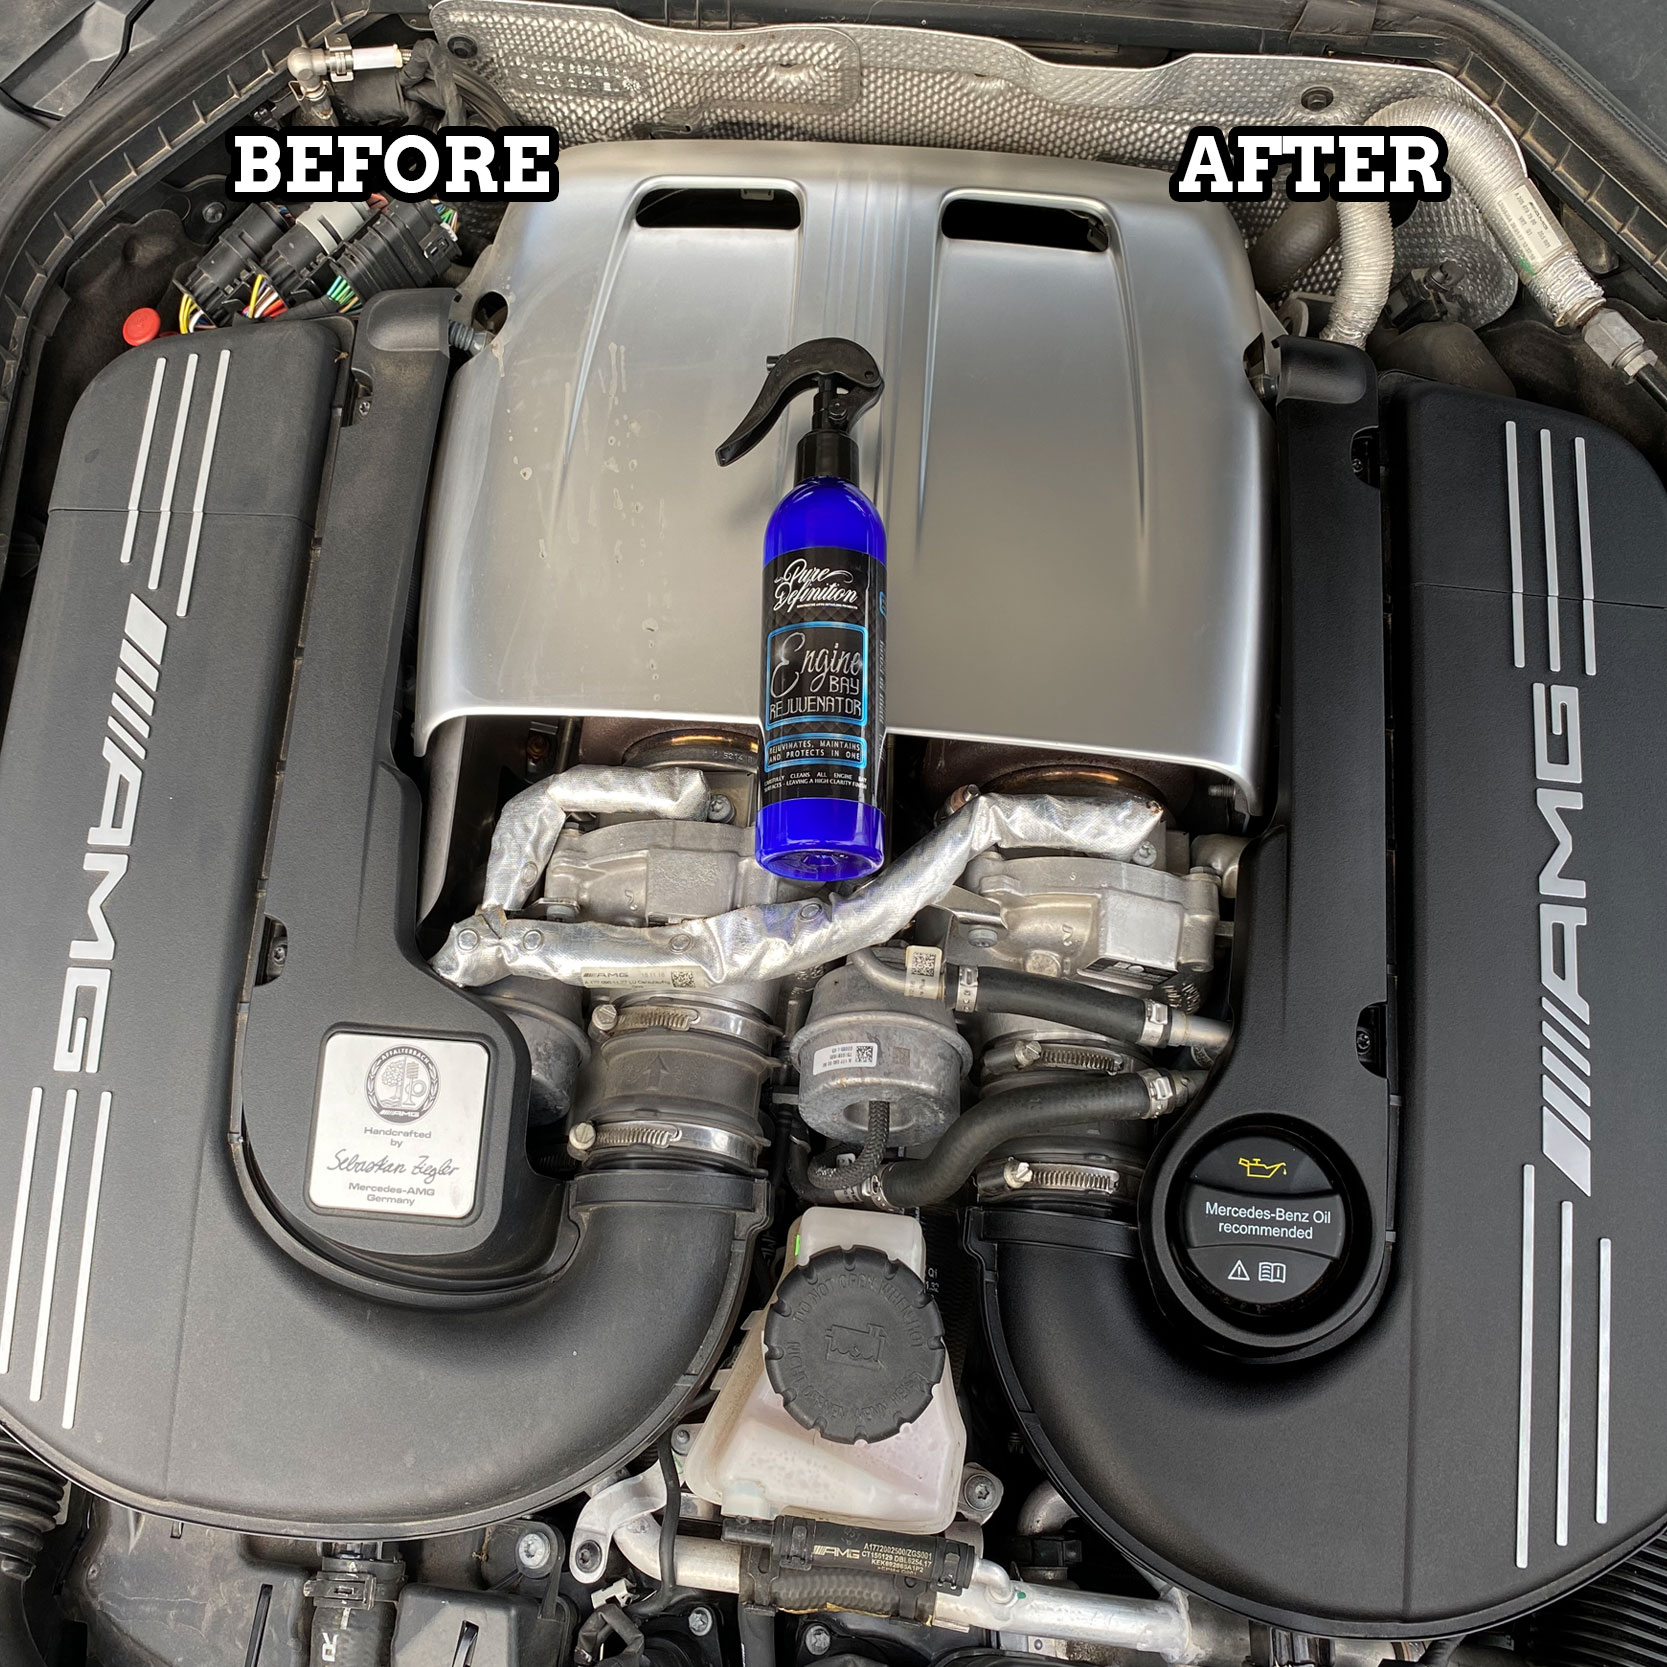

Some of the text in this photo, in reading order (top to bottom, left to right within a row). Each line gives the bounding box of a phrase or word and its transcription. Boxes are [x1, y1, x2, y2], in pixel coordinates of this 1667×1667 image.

[774, 559, 854, 586] Pure
[773, 582, 858, 612] Definition
[770, 632, 863, 698] Engine
[829, 676, 860, 695] BAY
[770, 696, 862, 720] REJUVENATOR
[820, 740, 860, 751] MAINTAINS
[769, 753, 781, 763] AND
[785, 749, 825, 758] PROTECTS
[845, 751, 860, 760] ONE
[833, 772, 853, 780] ENGINE
[1532, 682, 1590, 1026] AMG
[53, 737, 144, 1074] AMG
[381, 1048, 430, 1065] AFFALTERBACH
[364, 1127, 432, 1139] Handcrafted
[390, 1138, 403, 1148] by
[349, 1182, 435, 1196] Mercedes-AMG
[367, 1194, 415, 1206] Germany
[1205, 1201, 1331, 1224] Mercedes-Benz Oil
[1218, 1222, 1313, 1239] recommended
[822, 1546, 860, 1560] AMG
